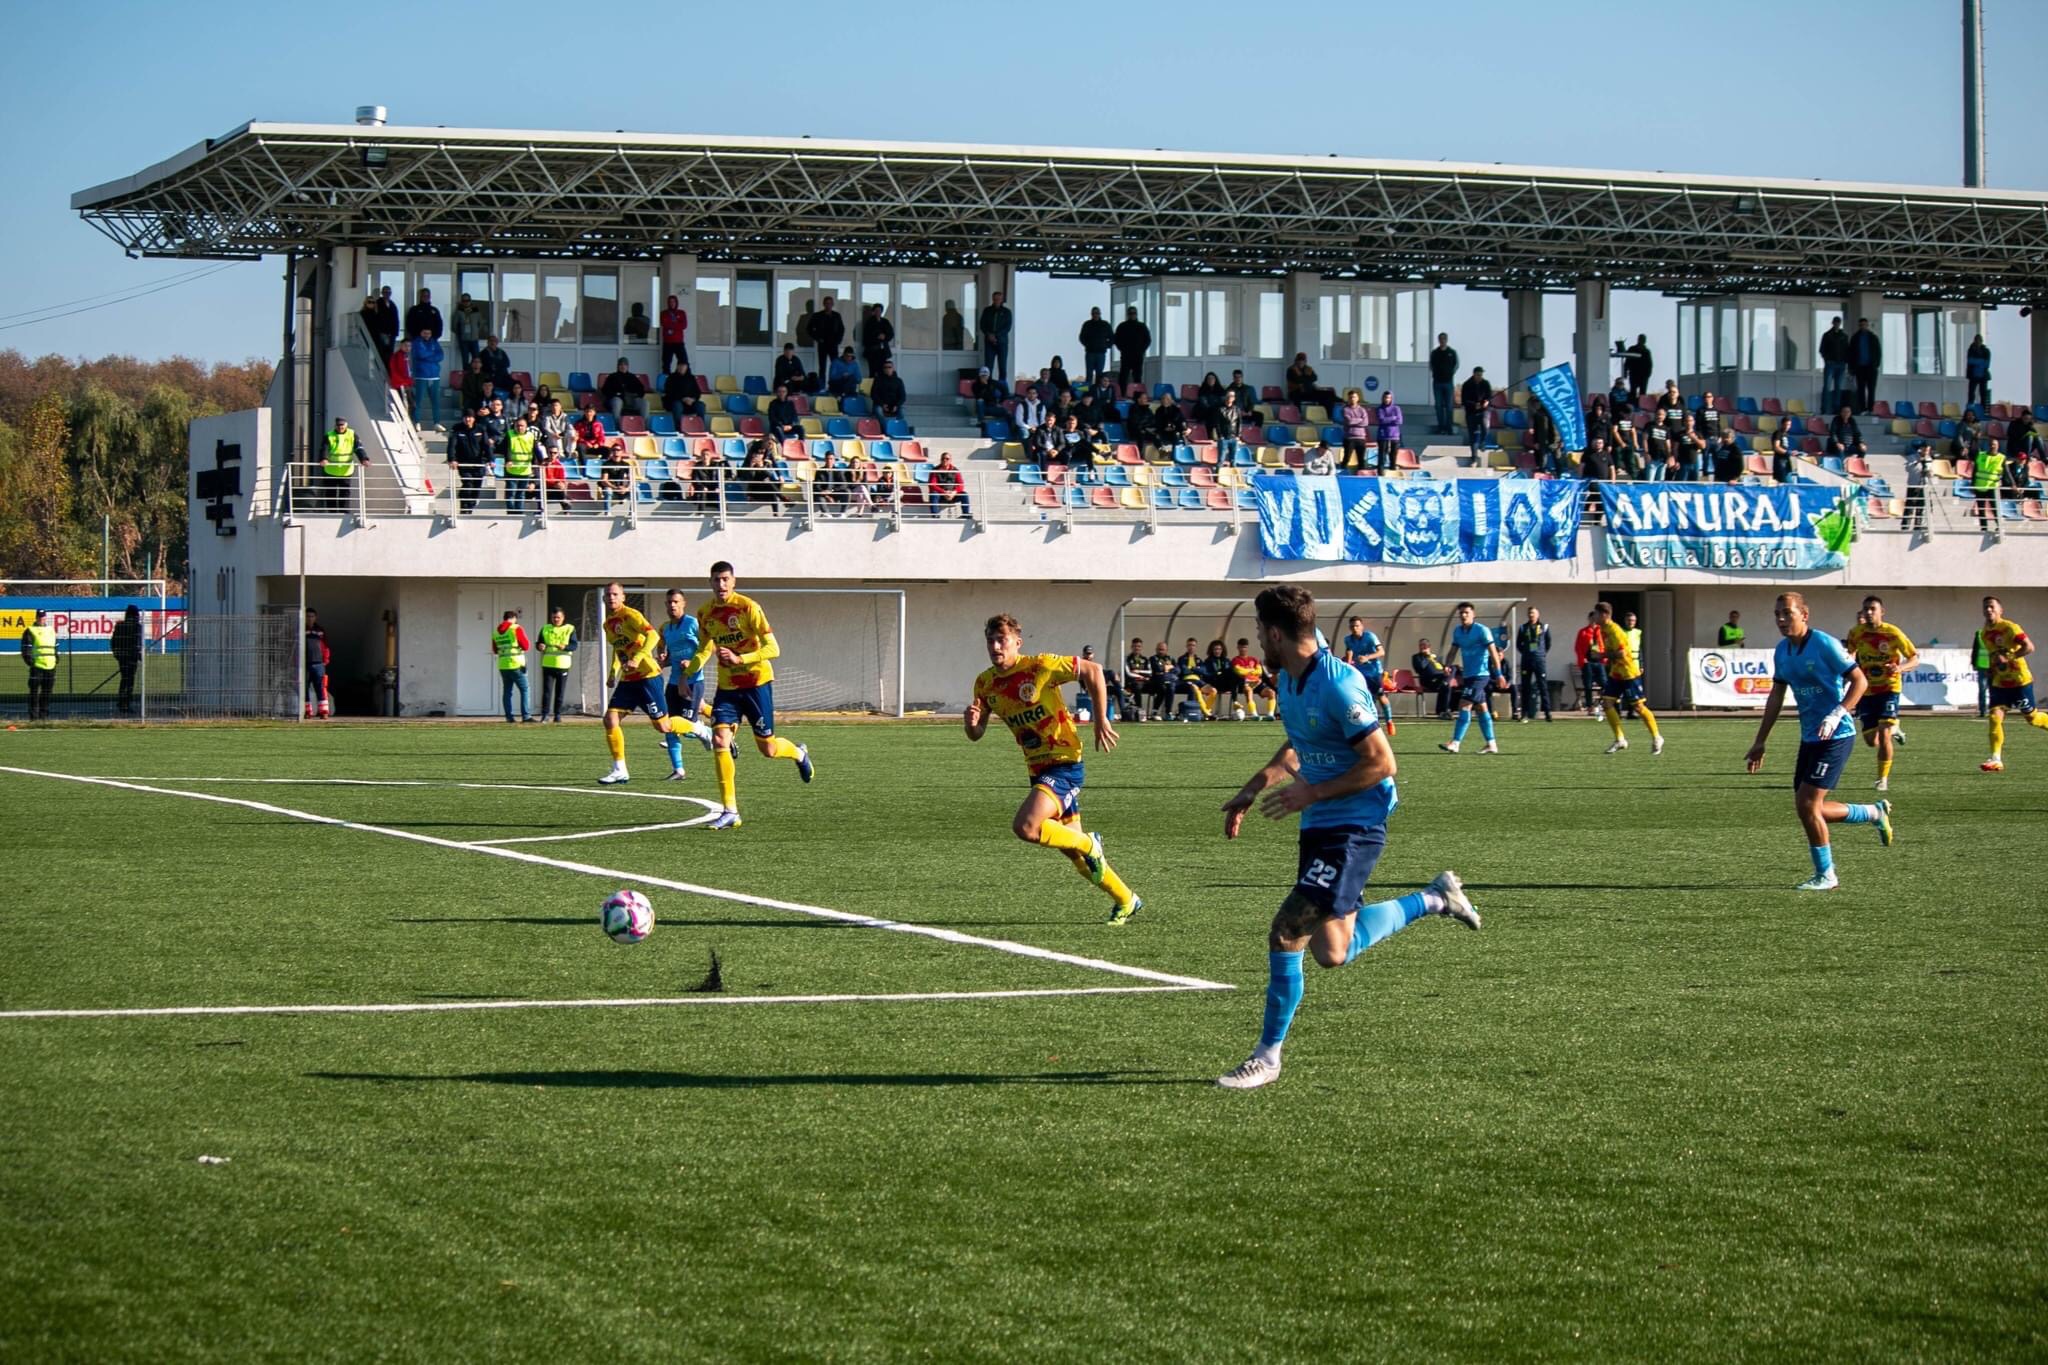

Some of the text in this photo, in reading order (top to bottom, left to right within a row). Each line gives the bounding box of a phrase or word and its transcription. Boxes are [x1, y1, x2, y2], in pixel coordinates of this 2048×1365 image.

[1613, 491, 1801, 532] ANTURAJ
[1610, 540, 1798, 568] bleu-albastru
[53, 614, 121, 635] Pamb
[1730, 662, 1768, 675] LIGA
[755, 716, 766, 730] 4
[1305, 858, 1337, 888] 22
